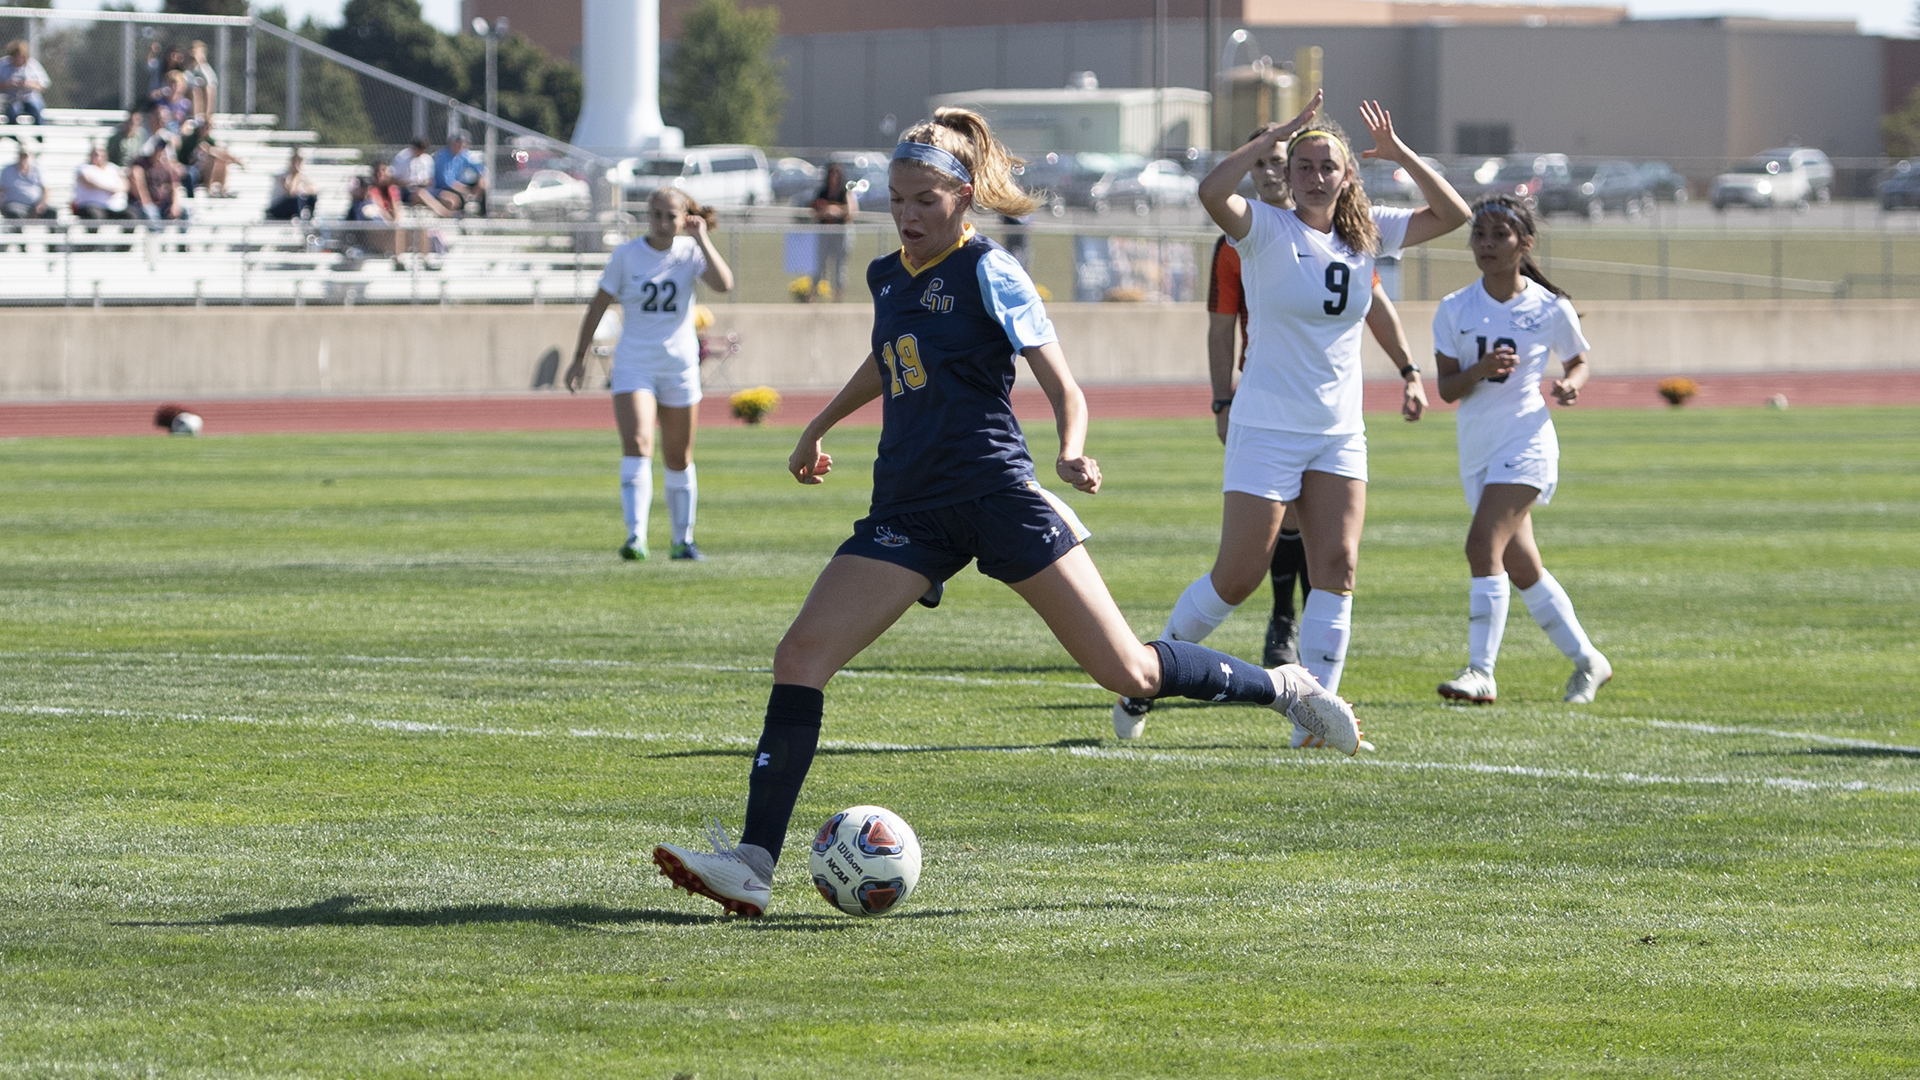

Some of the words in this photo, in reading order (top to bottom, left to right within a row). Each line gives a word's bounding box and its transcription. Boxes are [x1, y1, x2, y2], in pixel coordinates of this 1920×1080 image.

[642, 281, 677, 312] 22
[1323, 262, 1350, 315] 9
[882, 333, 927, 398] 19
[825, 857, 850, 885] NCAA
[837, 841, 863, 875] Wilson
